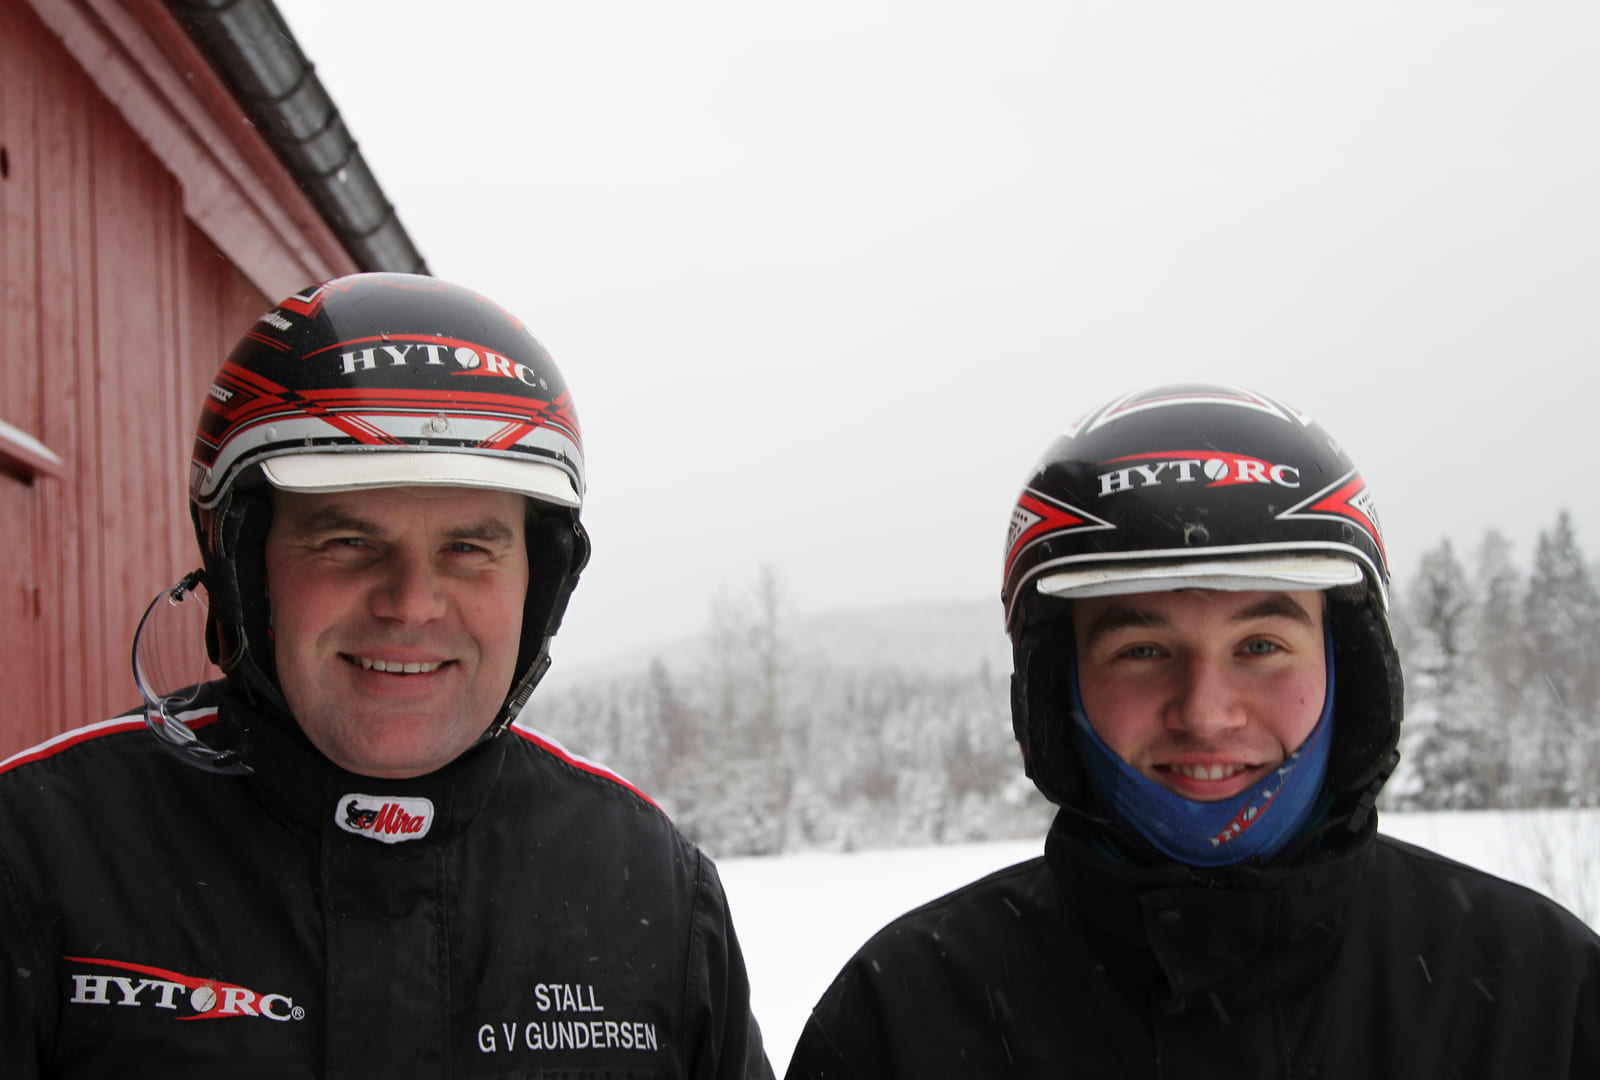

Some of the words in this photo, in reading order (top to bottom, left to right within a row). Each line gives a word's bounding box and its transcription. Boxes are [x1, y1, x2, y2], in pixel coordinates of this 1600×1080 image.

[1098, 457, 1300, 497] HYTORC
[358, 803, 425, 834] Mira
[534, 983, 604, 1012] STALL
[478, 1024, 496, 1052] G
[502, 1023, 517, 1052] V
[525, 1021, 658, 1051] GUNDERSEN
